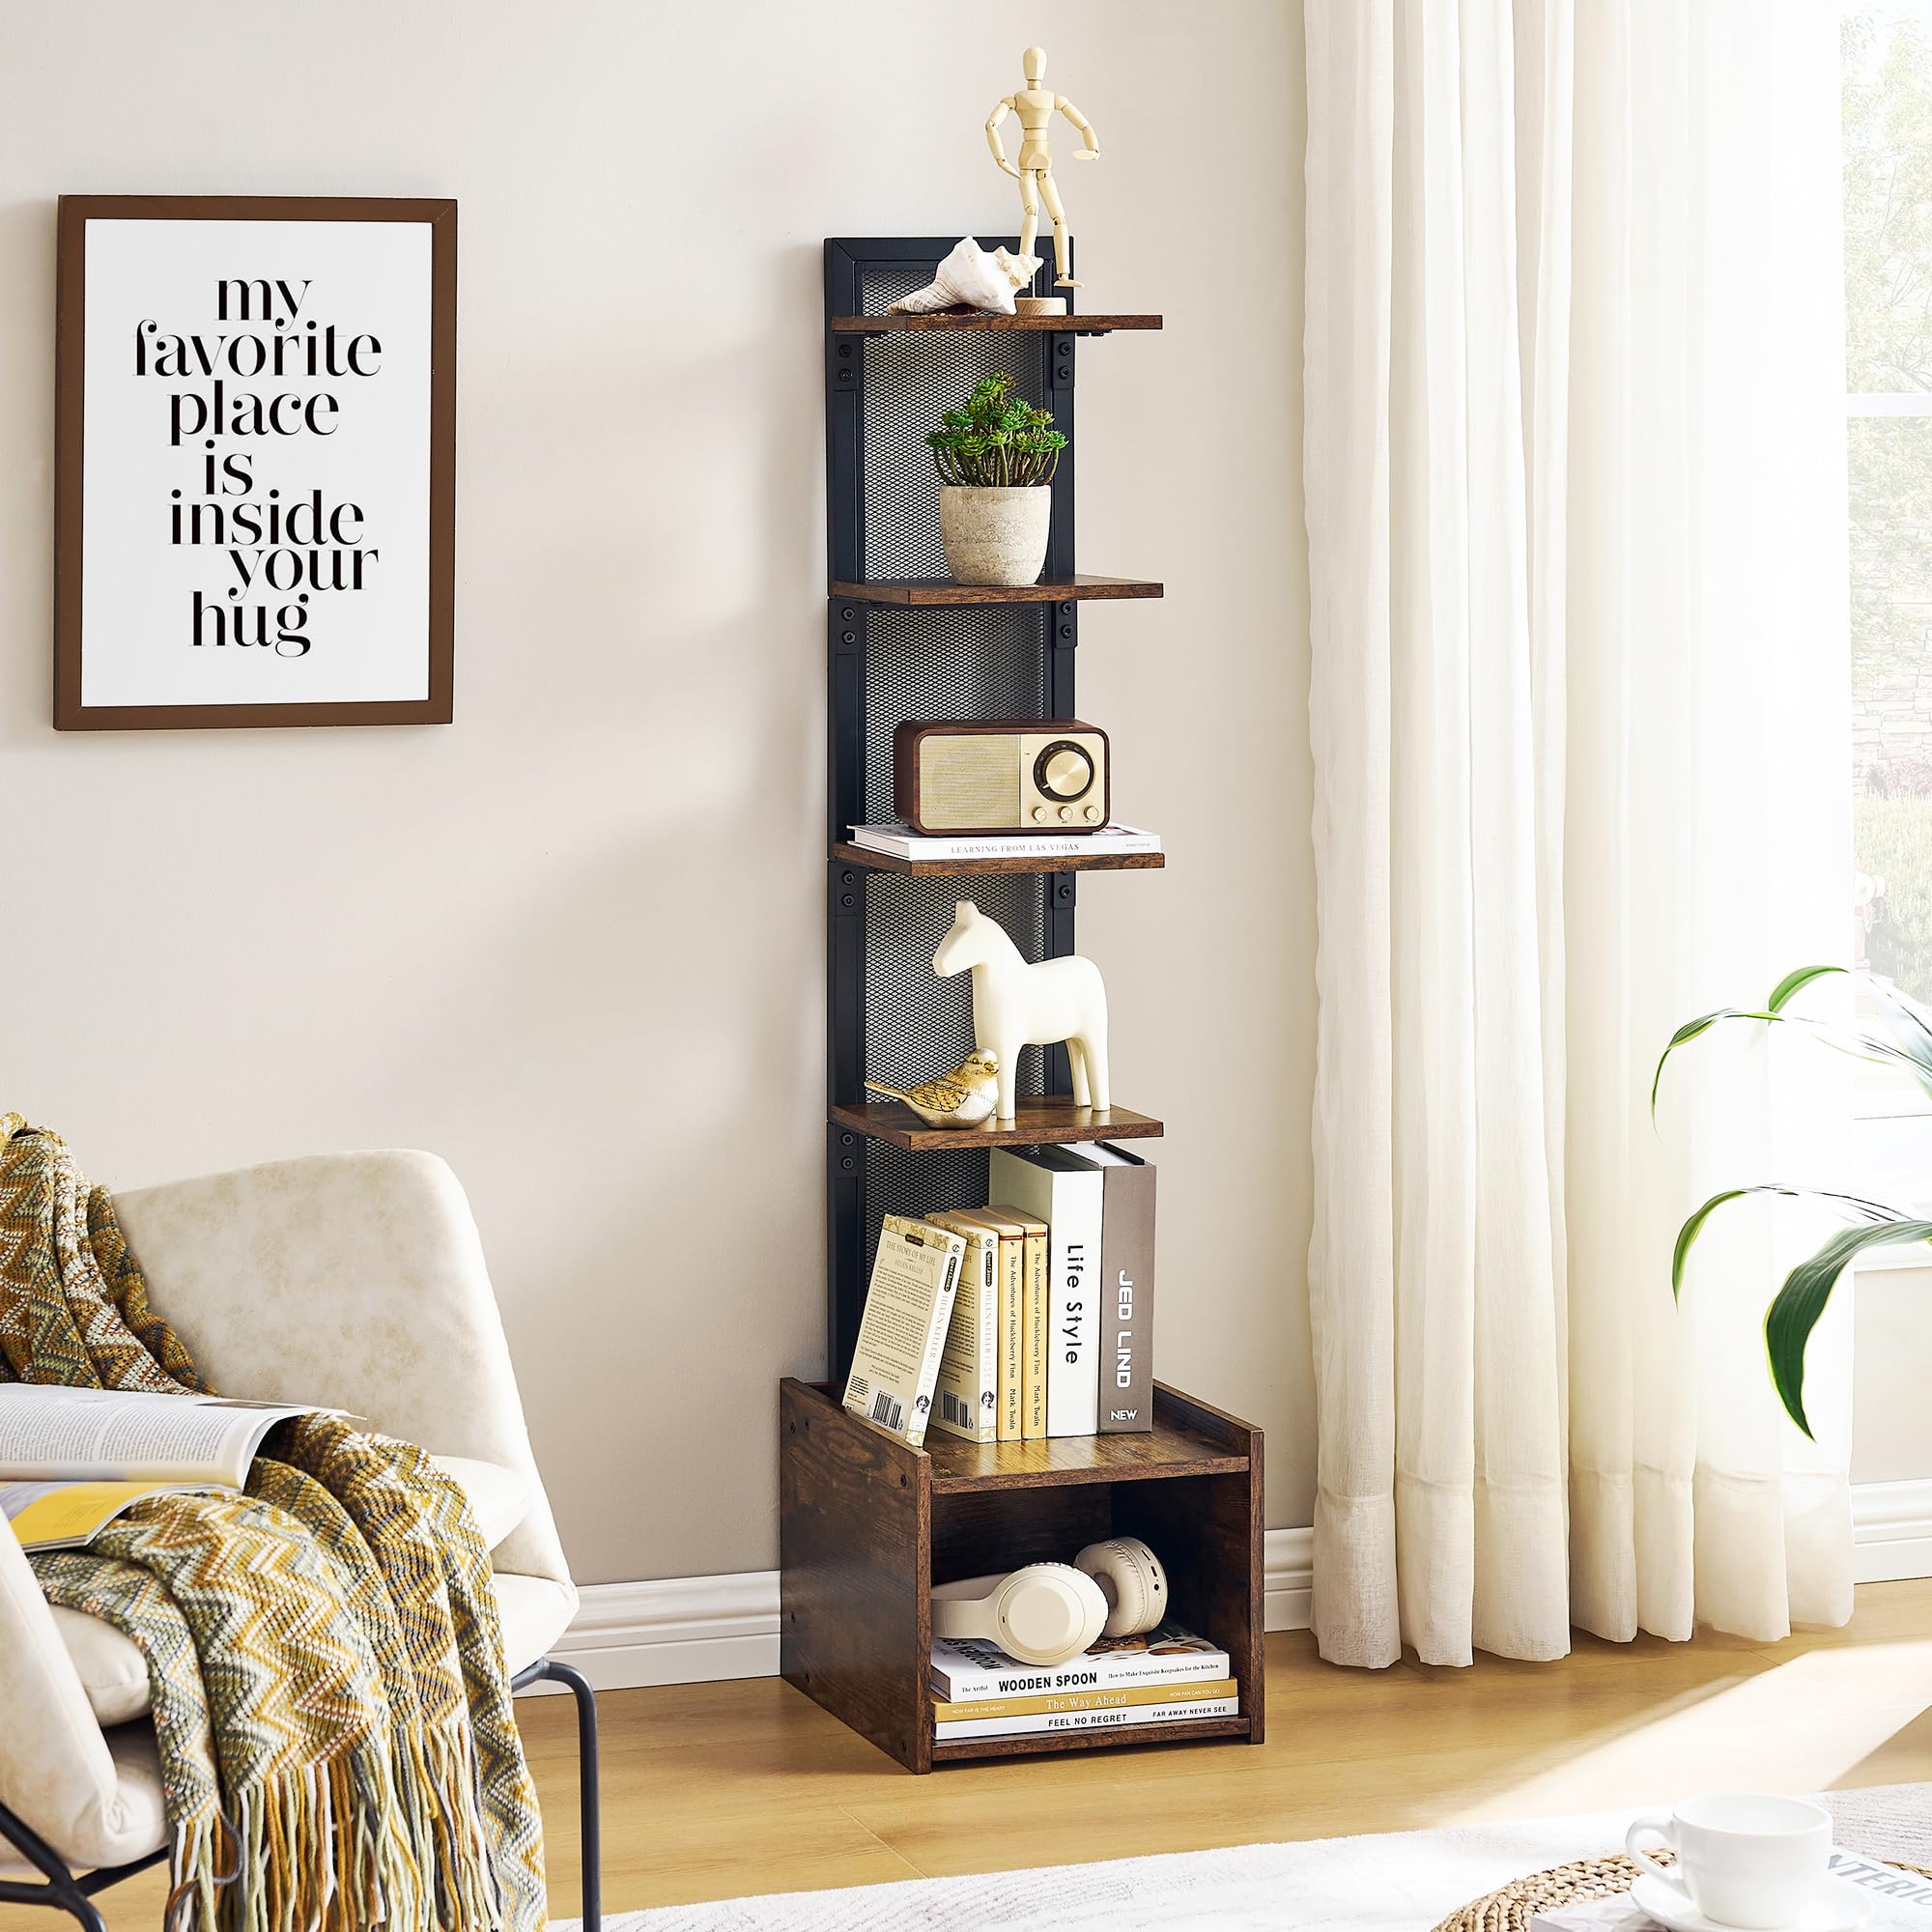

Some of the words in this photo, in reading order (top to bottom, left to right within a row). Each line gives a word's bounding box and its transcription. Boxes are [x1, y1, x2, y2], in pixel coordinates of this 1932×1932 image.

[214, 279, 312, 331] my
[132, 319, 383, 377] favorite
[167, 380, 339, 446] place
[201, 440, 253, 496] is
[167, 489, 364, 546] inside
[225, 549, 379, 602] your
[189, 591, 311, 658] hug
[1001, 844, 1026, 853] FROM
[1067, 1244, 1084, 1289] Life
[1118, 1268, 1133, 1321] JED
[1063, 1301, 1083, 1365] Style
[1117, 1330, 1132, 1389] LIND
[1110, 1408, 1138, 1421] NEW
[999, 1676, 1051, 1692] WOODEN
[1056, 1671, 1097, 1687] SPOON
[1046, 1698, 1065, 1710] The
[1069, 1697, 1091, 1709] Way
[1095, 1694, 1127, 1707] Ahead
[1048, 1719, 1070, 1727] FEEL
[1074, 1717, 1088, 1725] NO
[1092, 1714, 1127, 1724] REGRET
